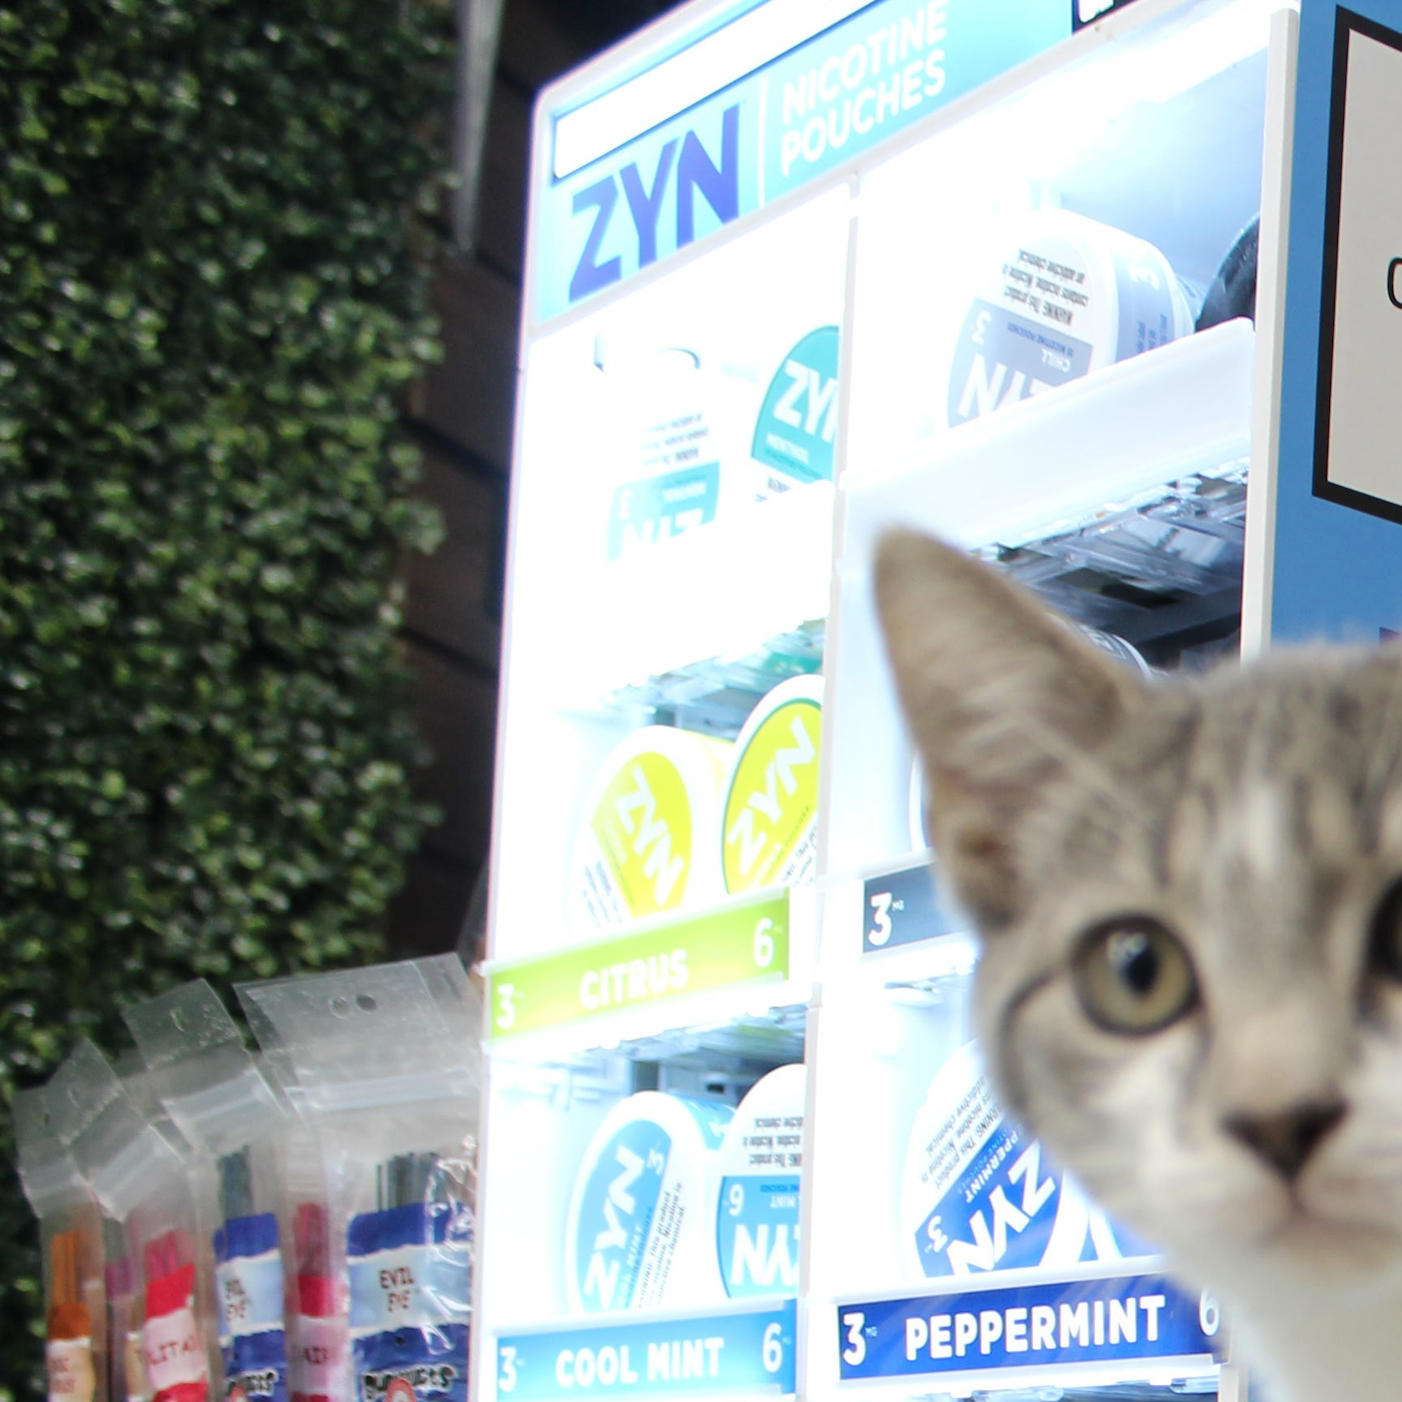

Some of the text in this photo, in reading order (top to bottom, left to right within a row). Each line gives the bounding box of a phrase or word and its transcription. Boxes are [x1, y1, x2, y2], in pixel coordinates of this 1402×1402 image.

[781, 2, 948, 118] NICOTINE
[780, 50, 948, 177] POUCHES
[569, 103, 740, 302] ZYN
[970, 310, 992, 346] 3
[1040, 348, 1072, 373] CHILL
[727, 714, 817, 879] ZYN
[613, 764, 684, 907] ZYN
[867, 892, 893, 947] 3
[496, 916, 776, 1030] 3 CITRUS 6
[646, 1147, 664, 1176] 3
[728, 1183, 744, 1217] 6
[958, 1126, 1026, 1203] PPERMINT
[582, 1144, 645, 1308] ZYN
[926, 1214, 949, 1254] 3
[946, 1138, 1058, 1277] ZYN
[498, 1322, 783, 1393] 3 COOL MINT 6
[842, 1312, 867, 1366] 3
[904, 1295, 1166, 1362] PEPPERMINT
